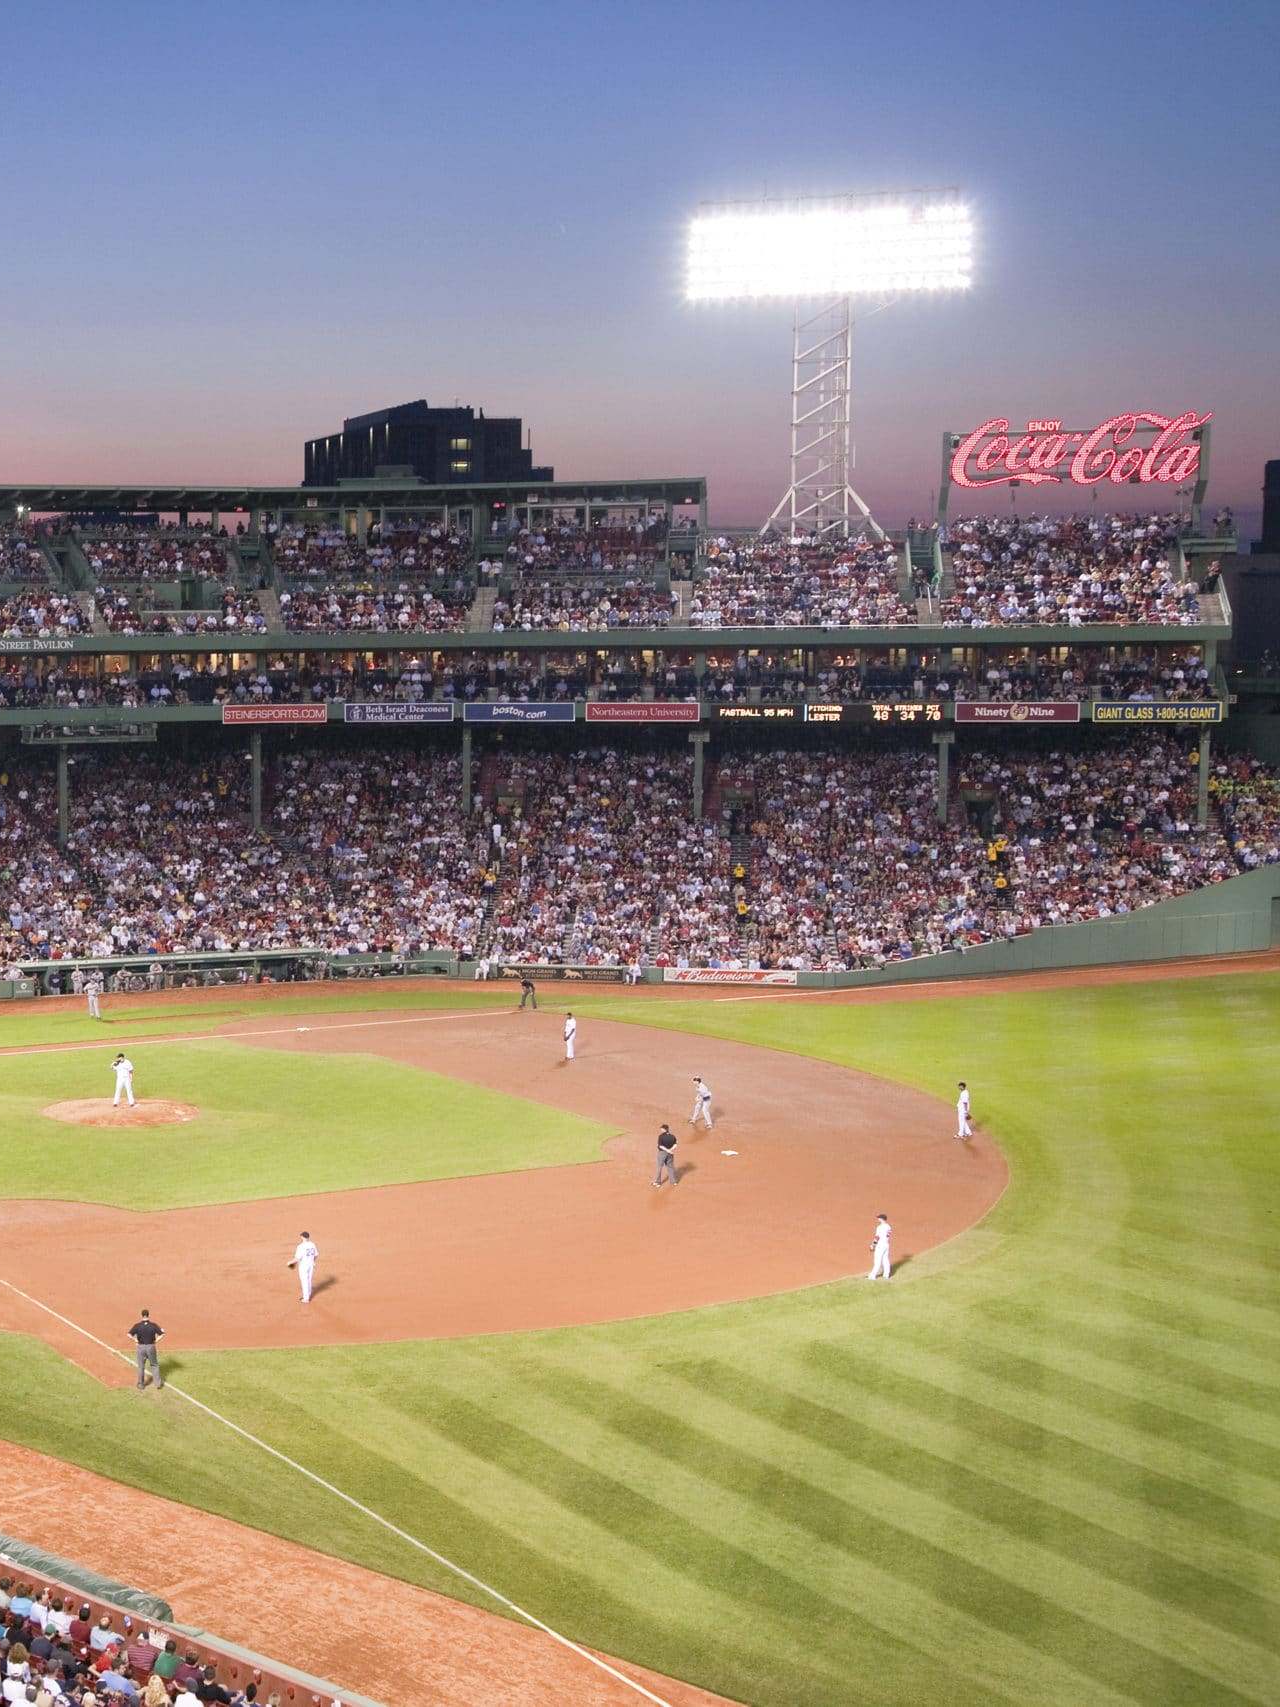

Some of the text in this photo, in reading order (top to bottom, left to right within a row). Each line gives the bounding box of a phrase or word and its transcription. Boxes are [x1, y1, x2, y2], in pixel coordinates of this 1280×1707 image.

[1028, 421, 1061, 432] ENJOY
[950, 411, 1213, 488] Coca-Cola
[0, 640, 30, 650] STREET
[33, 639, 74, 649] PAVILION
[224, 709, 326, 720] STEINERSPORTS.COM
[365, 705, 449, 714] Beth Israel Deaconess
[591, 707, 694, 718] Northeastern University
[720, 708, 761, 717] FASTBALL
[777, 708, 794, 717] MPH
[974, 707, 1010, 718] Ninety
[1030, 707, 1055, 717] Nine
[1096, 706, 1216, 720] GIANT GLASS 1-800-54 GIANT
[366, 713, 396, 721] Medical
[808, 713, 841, 721] LESTER
[873, 711, 941, 721] 48 34 70
[683, 969, 756, 982] Budweiser
